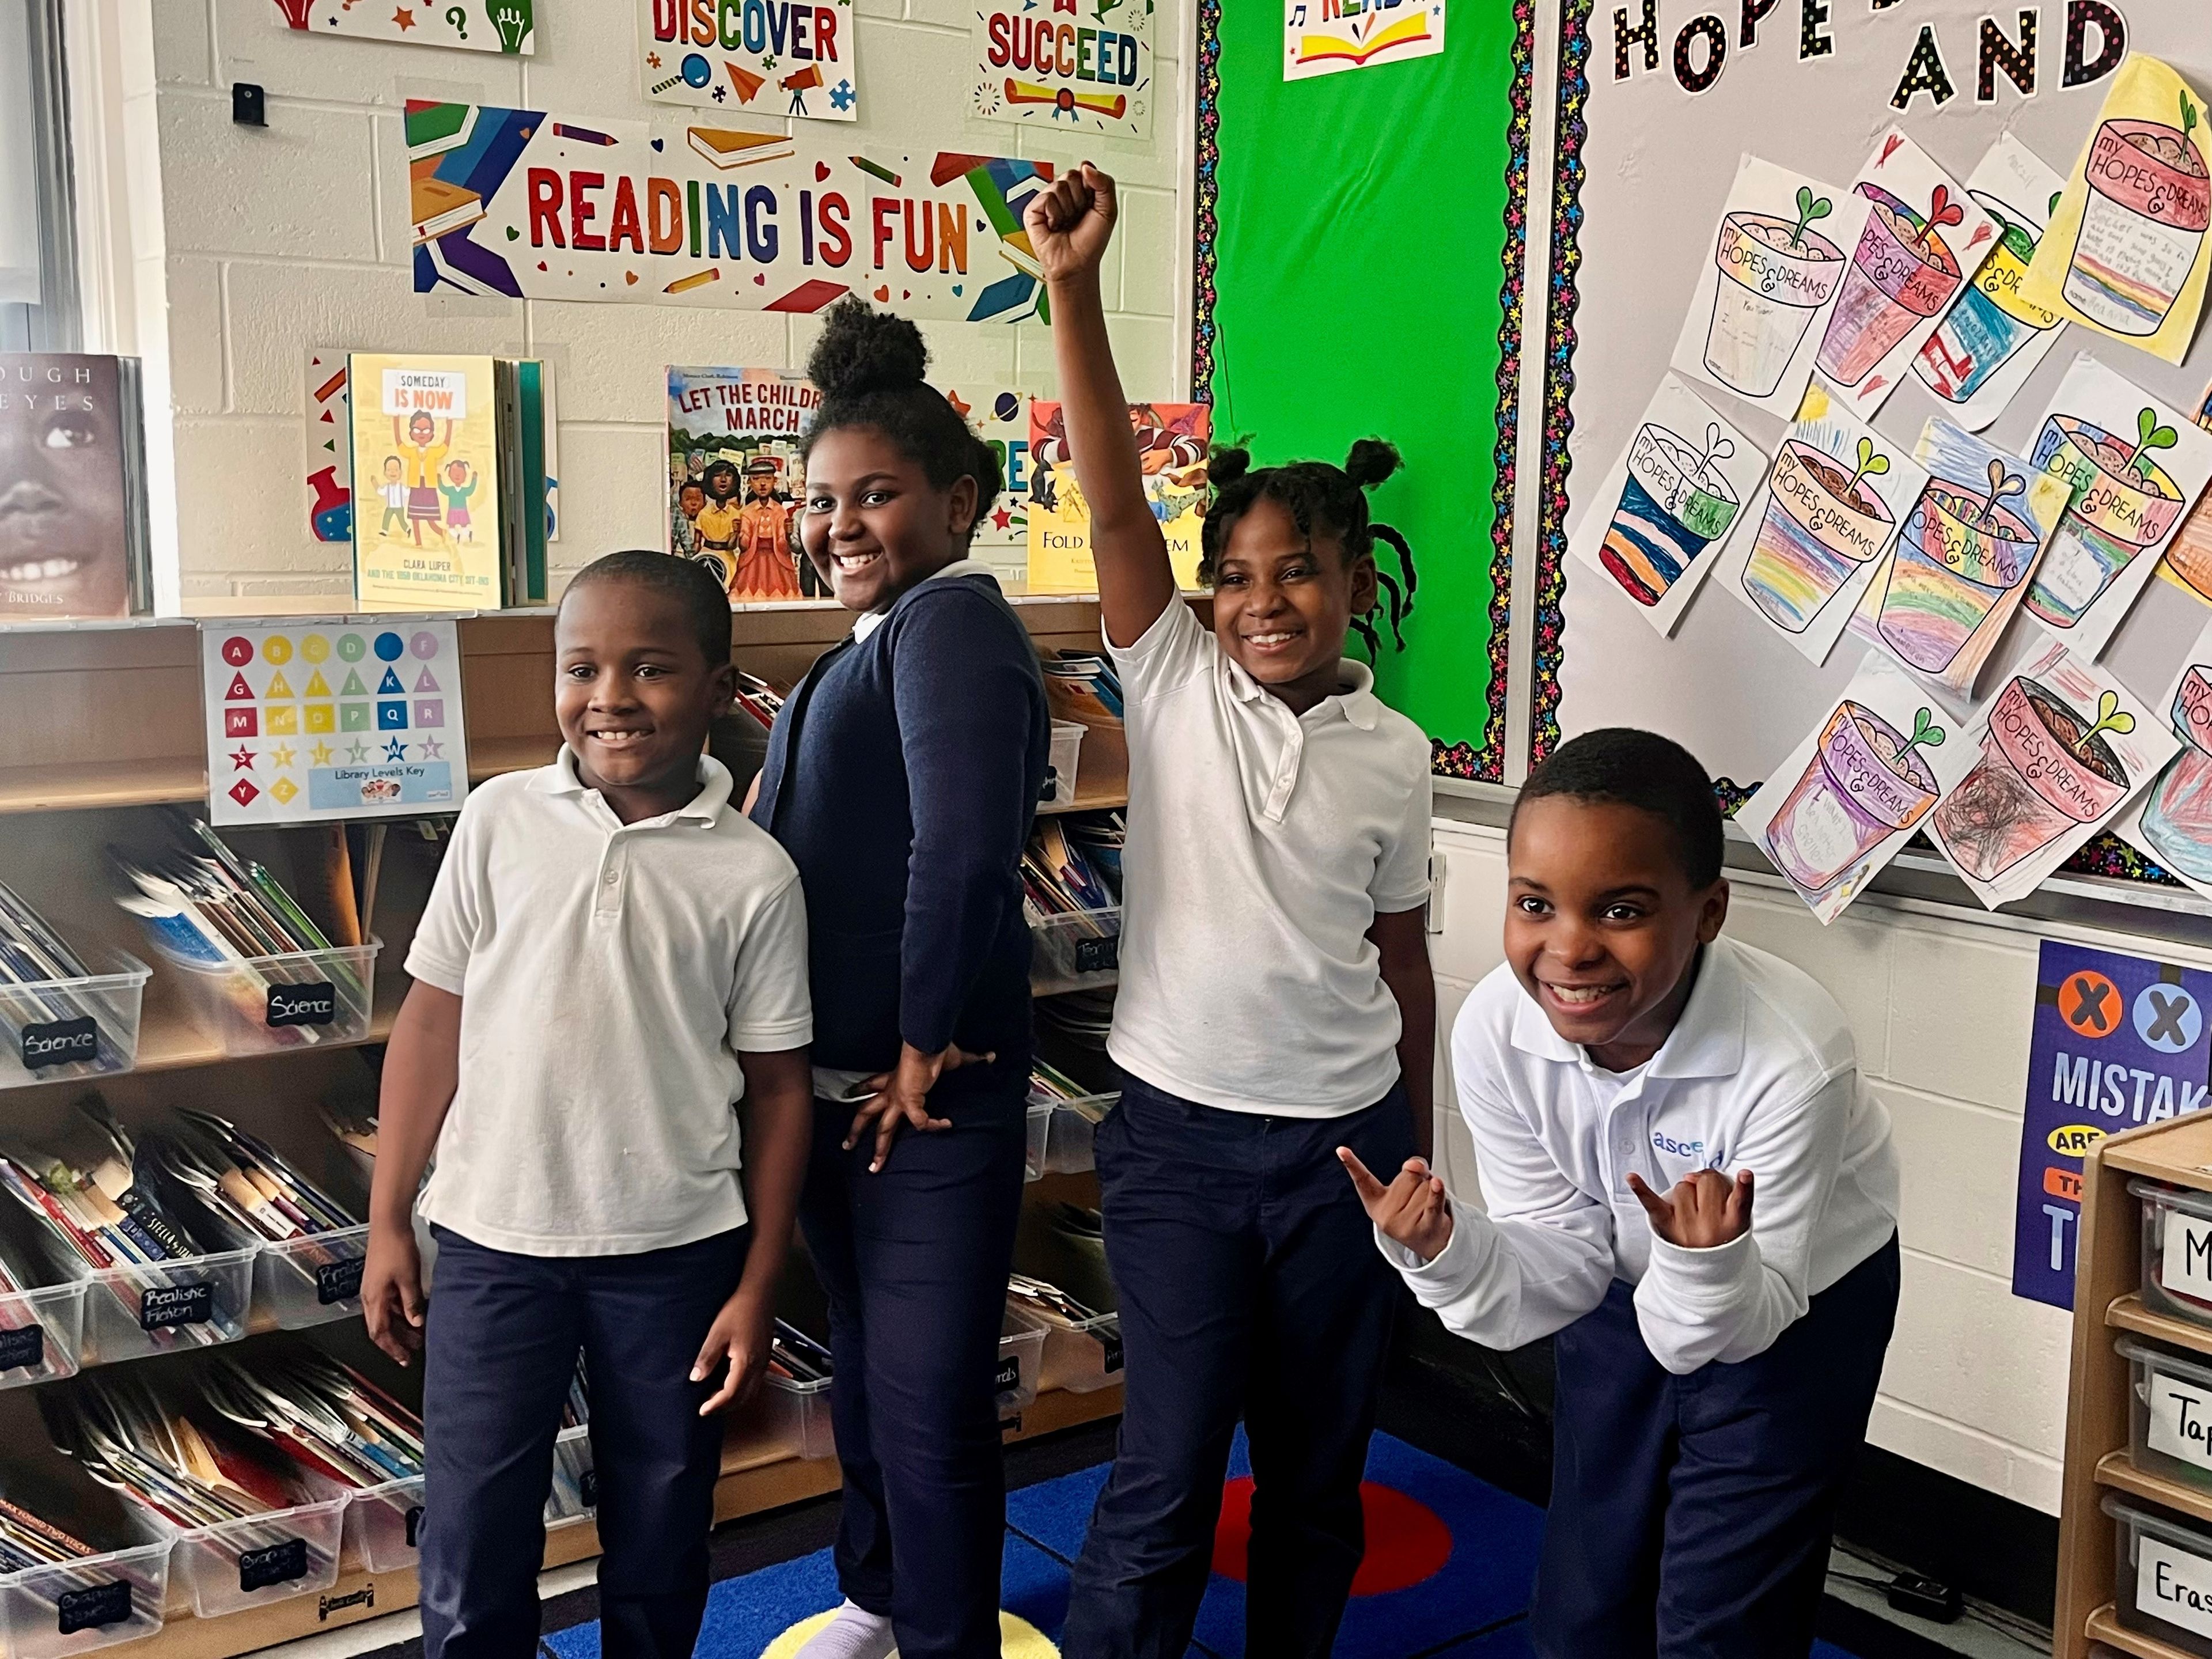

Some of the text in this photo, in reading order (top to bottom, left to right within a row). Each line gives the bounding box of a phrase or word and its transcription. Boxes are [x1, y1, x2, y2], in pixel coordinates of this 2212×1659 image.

[653, 0, 838, 63] DISCOVER
[987, 12, 1138, 86] SUCCEED
[1888, 0, 2128, 114] AND
[2091, 156, 2209, 224] HOPES & DREAMS
[528, 167, 967, 275] READING IS FUN
[1720, 246, 1828, 300] HOPES & DREAMS
[1873, 256, 1892, 282] &
[1892, 259, 1940, 312] DREAMS
[1983, 268, 2003, 292] &
[401, 375, 445, 388] SOMEDAY
[395, 388, 454, 410] IS NOW
[678, 387, 711, 414] LET
[715, 383, 752, 406] THE
[725, 407, 800, 433] MARCH
[1631, 453, 1722, 535] HOPES & DREAMS
[2036, 447, 2160, 540] HOPES & DREAMS
[1773, 469, 1819, 512] HOPES
[1809, 507, 1825, 531] &
[1824, 507, 1876, 557] DREAMS
[1043, 531, 1084, 549] FOLD
[403, 559, 451, 571] CLARA LUPER
[1944, 540, 1961, 565] &
[1960, 539, 2019, 582] DREAMS
[382, 570, 395, 579] THE
[232, 647, 241, 657] A
[272, 646, 281, 656] B
[346, 642, 355, 653] D
[421, 640, 427, 651] F
[234, 684, 244, 695] G
[274, 682, 283, 692] H
[385, 676, 395, 687] K
[423, 676, 430, 687] L
[233, 717, 247, 727] M
[275, 715, 285, 726] N
[351, 711, 358, 722] P
[387, 710, 399, 721] Q
[424, 709, 433, 719] R
[2177, 696, 2212, 733] HO
[238, 752, 246, 762] S
[388, 745, 401, 755] W
[1994, 703, 2101, 818] HOPES & DREAMS
[335, 766, 425, 781] Library Levels Key
[1823, 725, 1914, 825] HOPES & DREAMS
[238, 785, 288, 798] Y Z
[271, 995, 331, 1018] Science
[25, 1033, 93, 1054] Science
[147, 1218, 176, 1244] STELLA
[145, 1286, 207, 1306] Realistic
